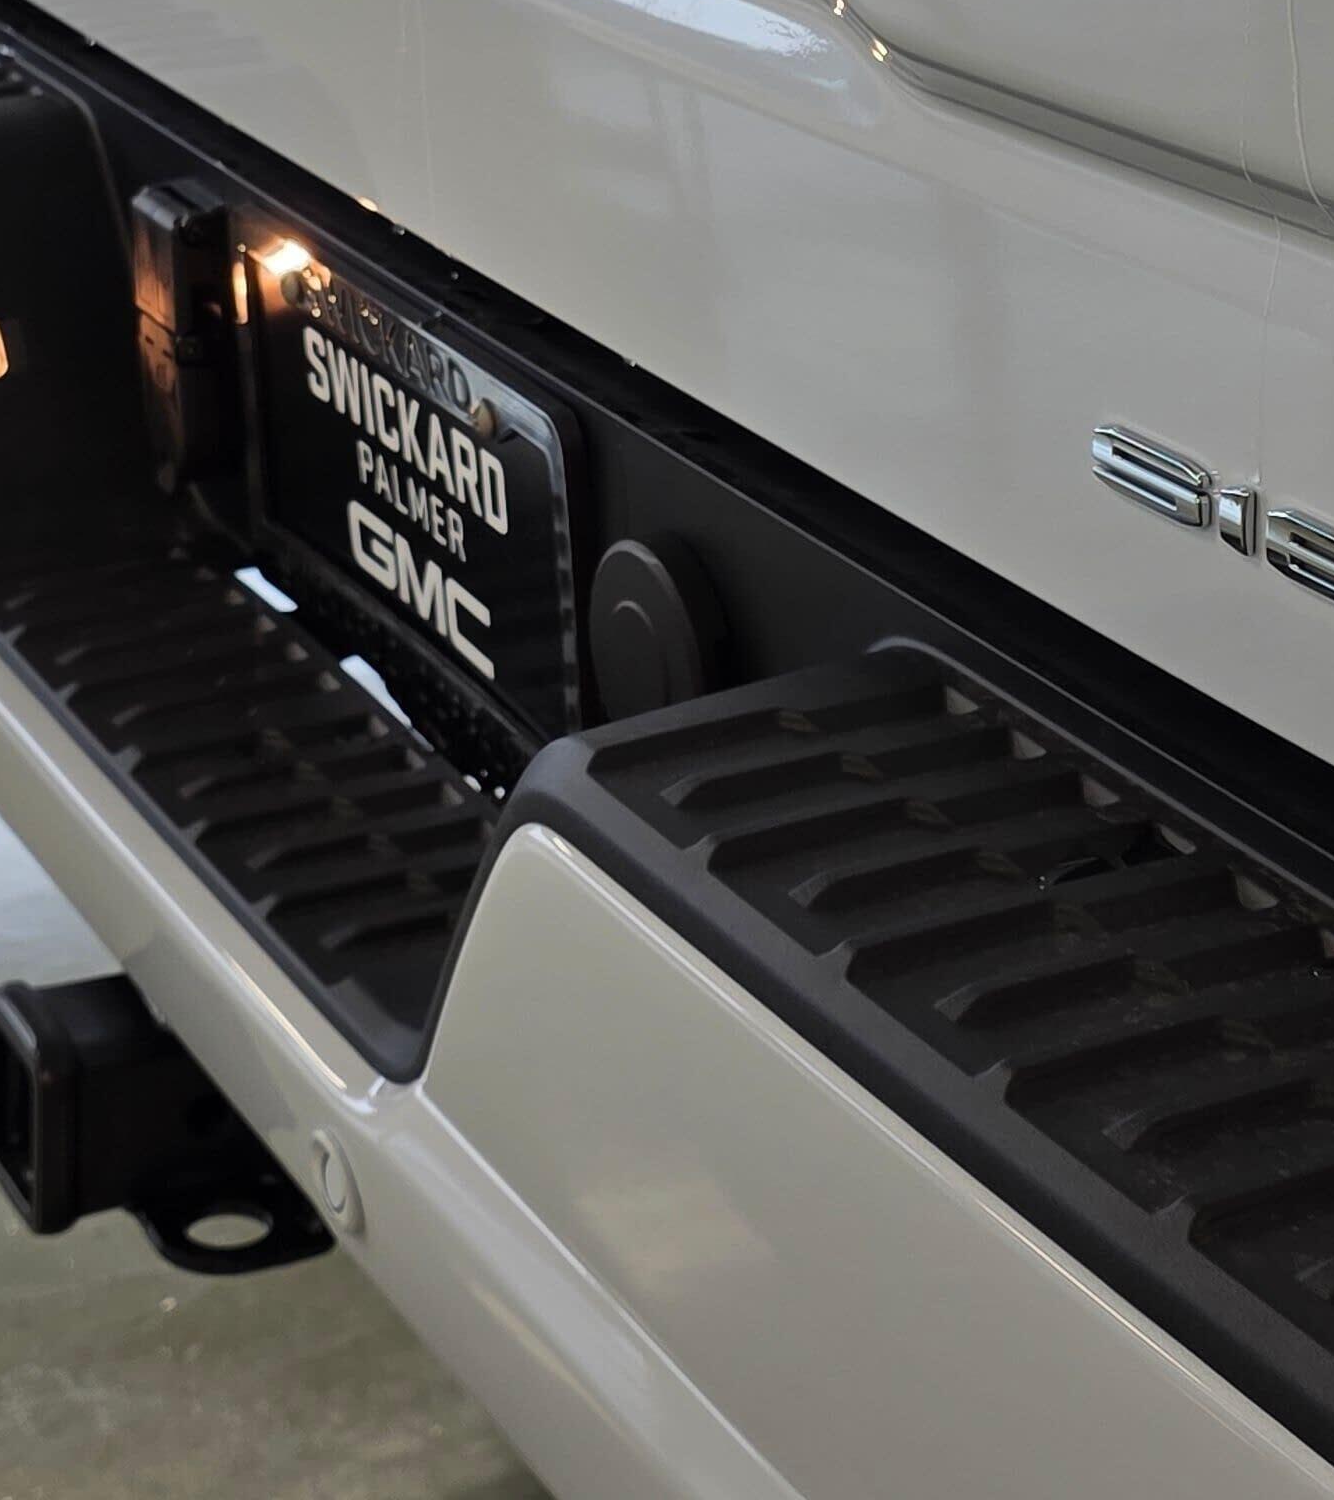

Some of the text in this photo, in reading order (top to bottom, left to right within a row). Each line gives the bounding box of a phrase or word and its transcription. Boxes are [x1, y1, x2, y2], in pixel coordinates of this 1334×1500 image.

[303, 325, 509, 535] SWICKARD
[357, 440, 467, 562] PALMER
[347, 500, 495, 680] GMC
